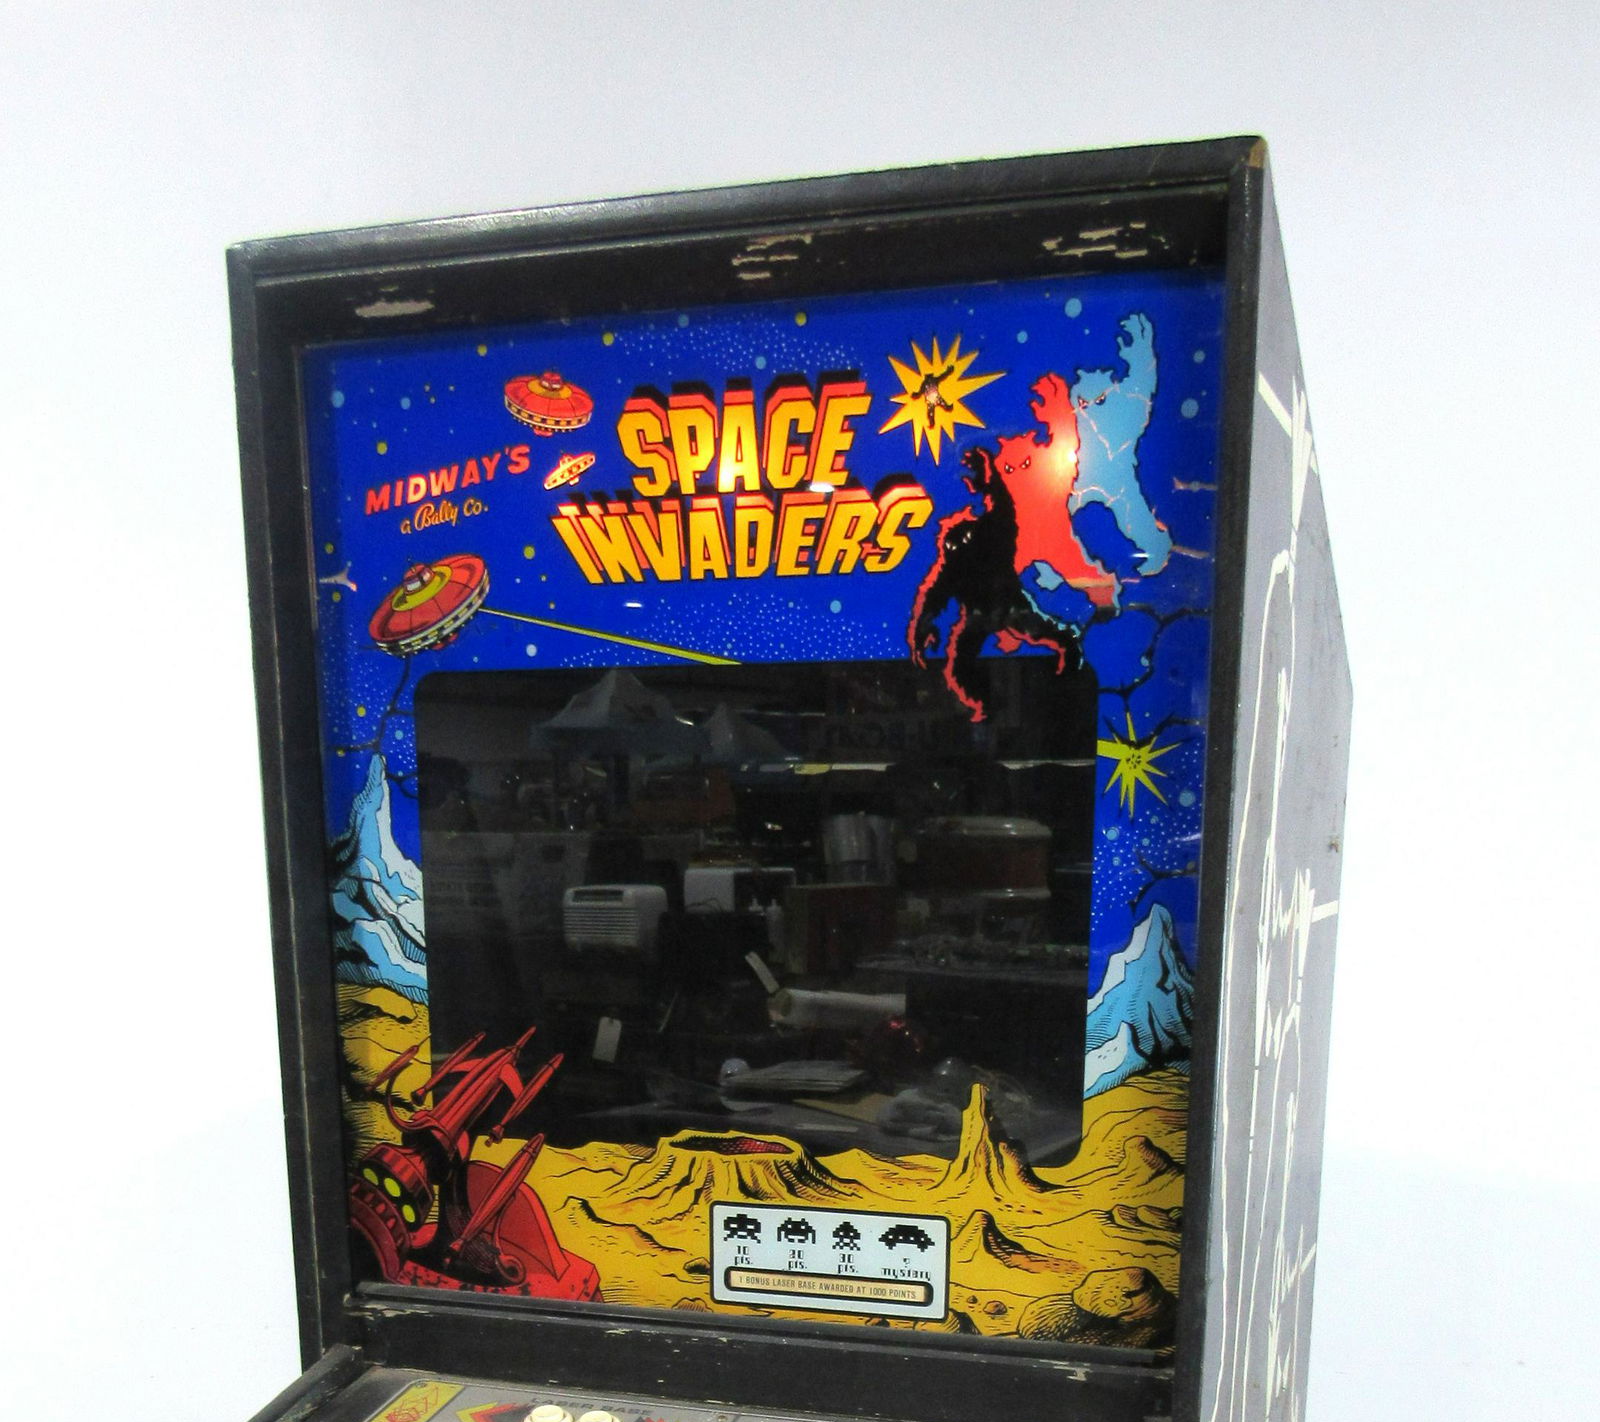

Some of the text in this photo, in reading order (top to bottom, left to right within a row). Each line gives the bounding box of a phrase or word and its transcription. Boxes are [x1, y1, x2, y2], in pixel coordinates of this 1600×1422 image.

[616, 380, 872, 498] SPACE
[365, 444, 531, 516] MIDWAY'S
[400, 498, 489, 535] a Bally Co.
[551, 486, 933, 584] INVADERS
[736, 1244, 750, 1256] 10
[838, 1253, 855, 1264] 30
[745, 1275, 770, 1287] BONUS
[772, 1278, 796, 1289] LASER
[797, 1280, 816, 1291] BASE
[819, 1282, 854, 1294] AWARDED
[856, 1285, 868, 1294] AT
[869, 1286, 887, 1297] 1000
[889, 1288, 917, 1299] POINTS
[880, 1267, 932, 1281] mystery
